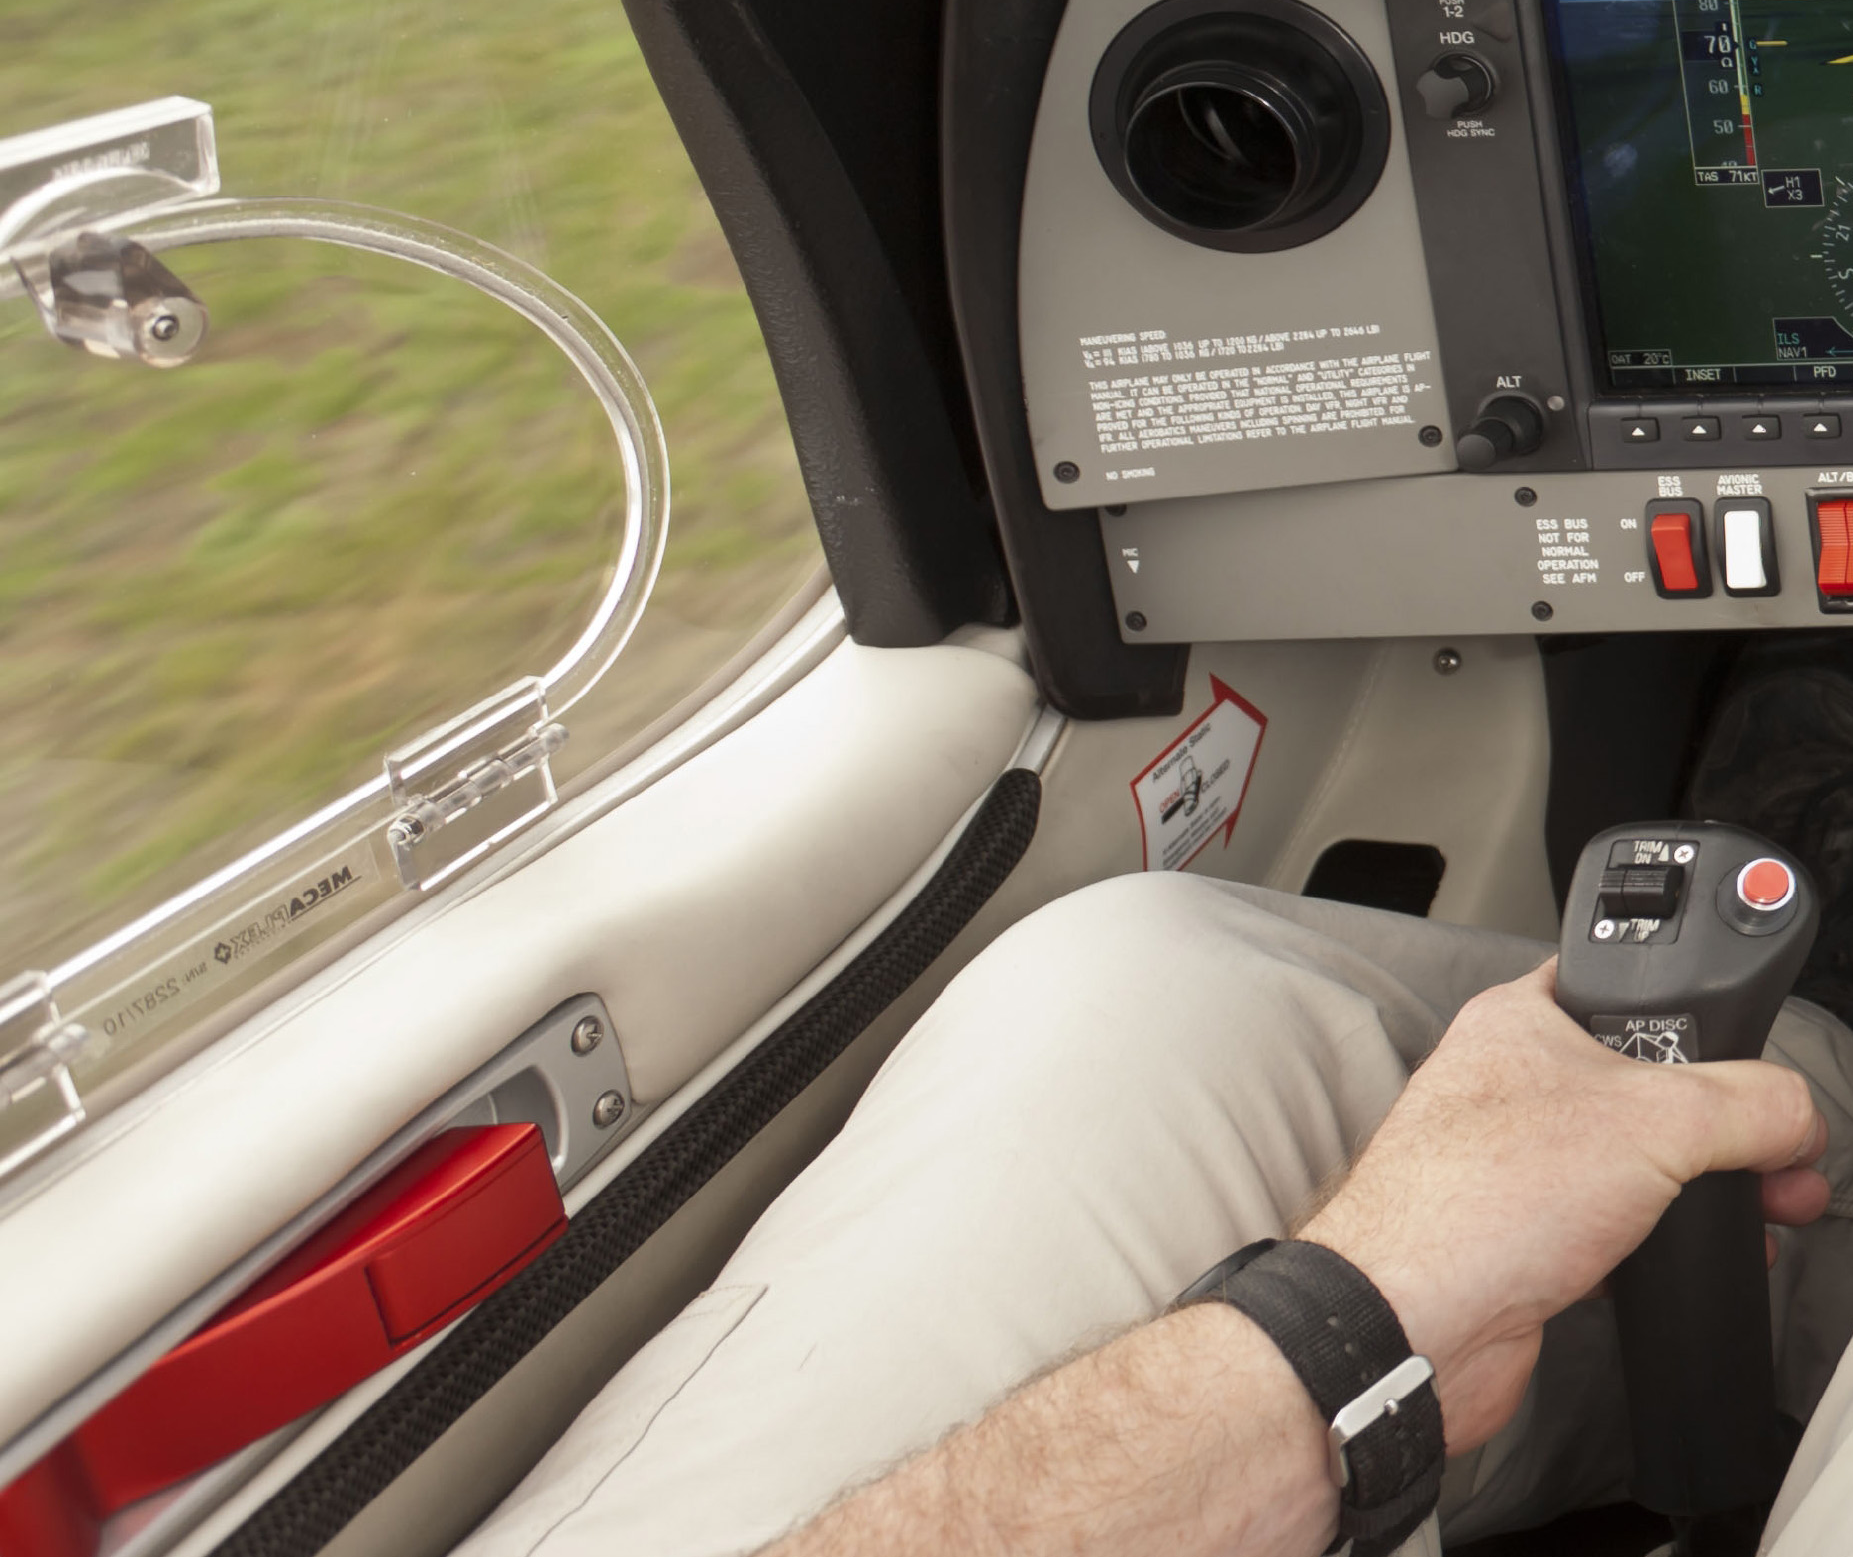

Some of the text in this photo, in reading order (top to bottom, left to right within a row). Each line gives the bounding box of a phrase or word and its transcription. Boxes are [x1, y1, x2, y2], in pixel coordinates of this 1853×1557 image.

[1440, 31, 1474, 44] HDG
[1695, 172, 1718, 183] TAS
[1814, 366, 1836, 377] PFD
[1497, 376, 1521, 388] ALT
[1106, 468, 1155, 480] NO SMOKING
[1626, 1018, 1687, 1032] AP DISC
